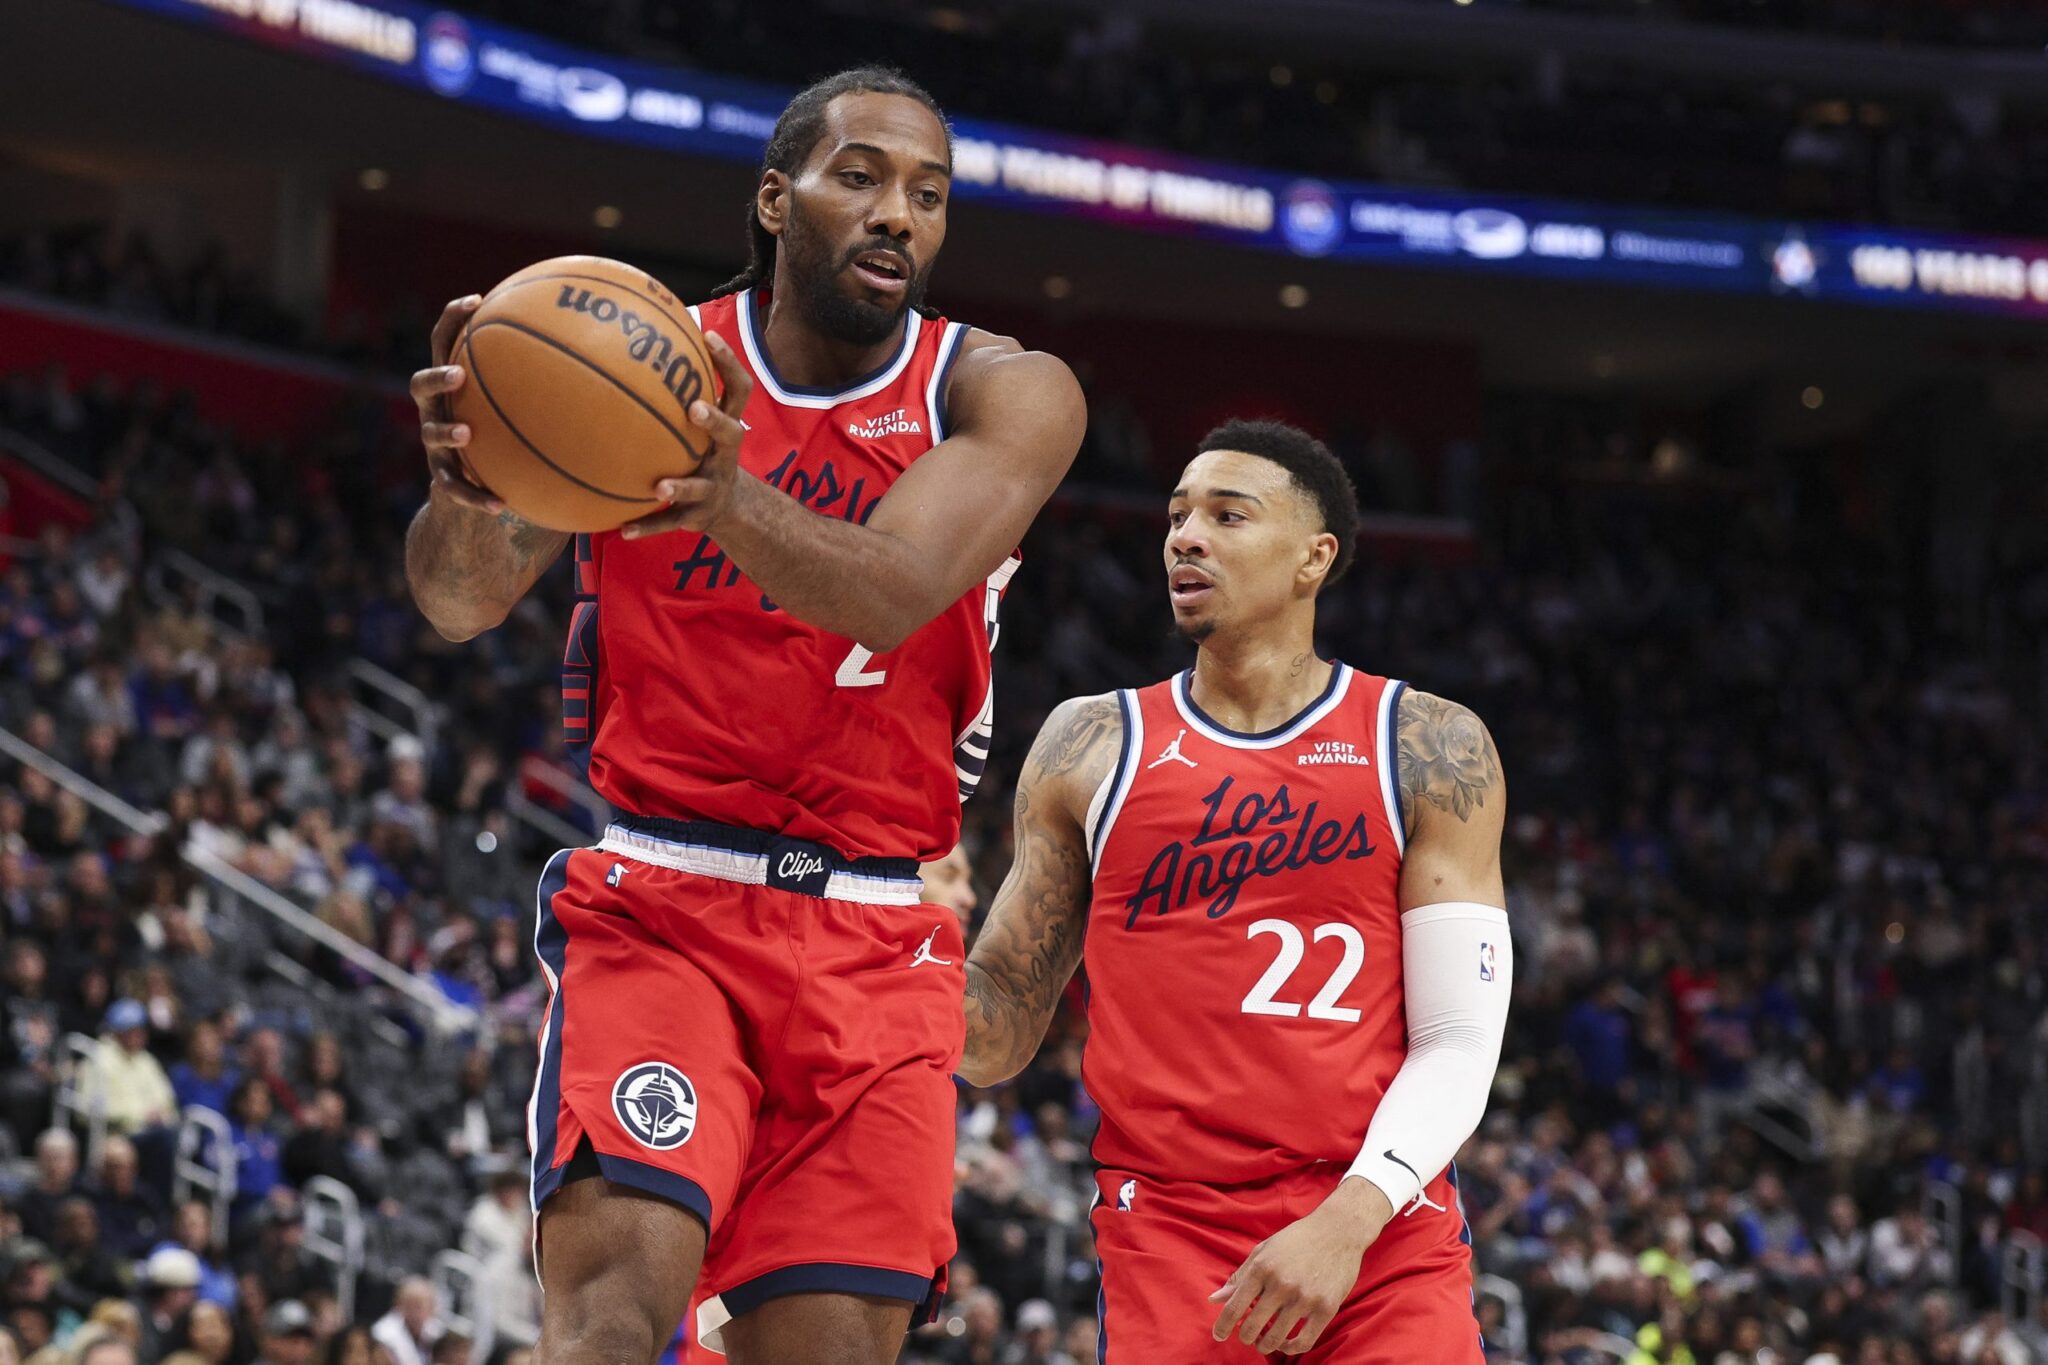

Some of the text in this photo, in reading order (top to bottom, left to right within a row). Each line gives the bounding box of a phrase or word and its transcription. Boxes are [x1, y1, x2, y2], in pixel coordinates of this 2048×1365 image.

[557, 284, 703, 418] Wilson
[849, 421, 921, 438] RWANDA
[866, 409, 905, 428] VISIT
[1298, 753, 1369, 765] RWANDA
[1314, 741, 1355, 754] VISIT
[1190, 775, 1299, 848] Los
[778, 851, 824, 882] Clips
[1125, 800, 1377, 931] Angeles
[1241, 918, 1365, 1023] 22
